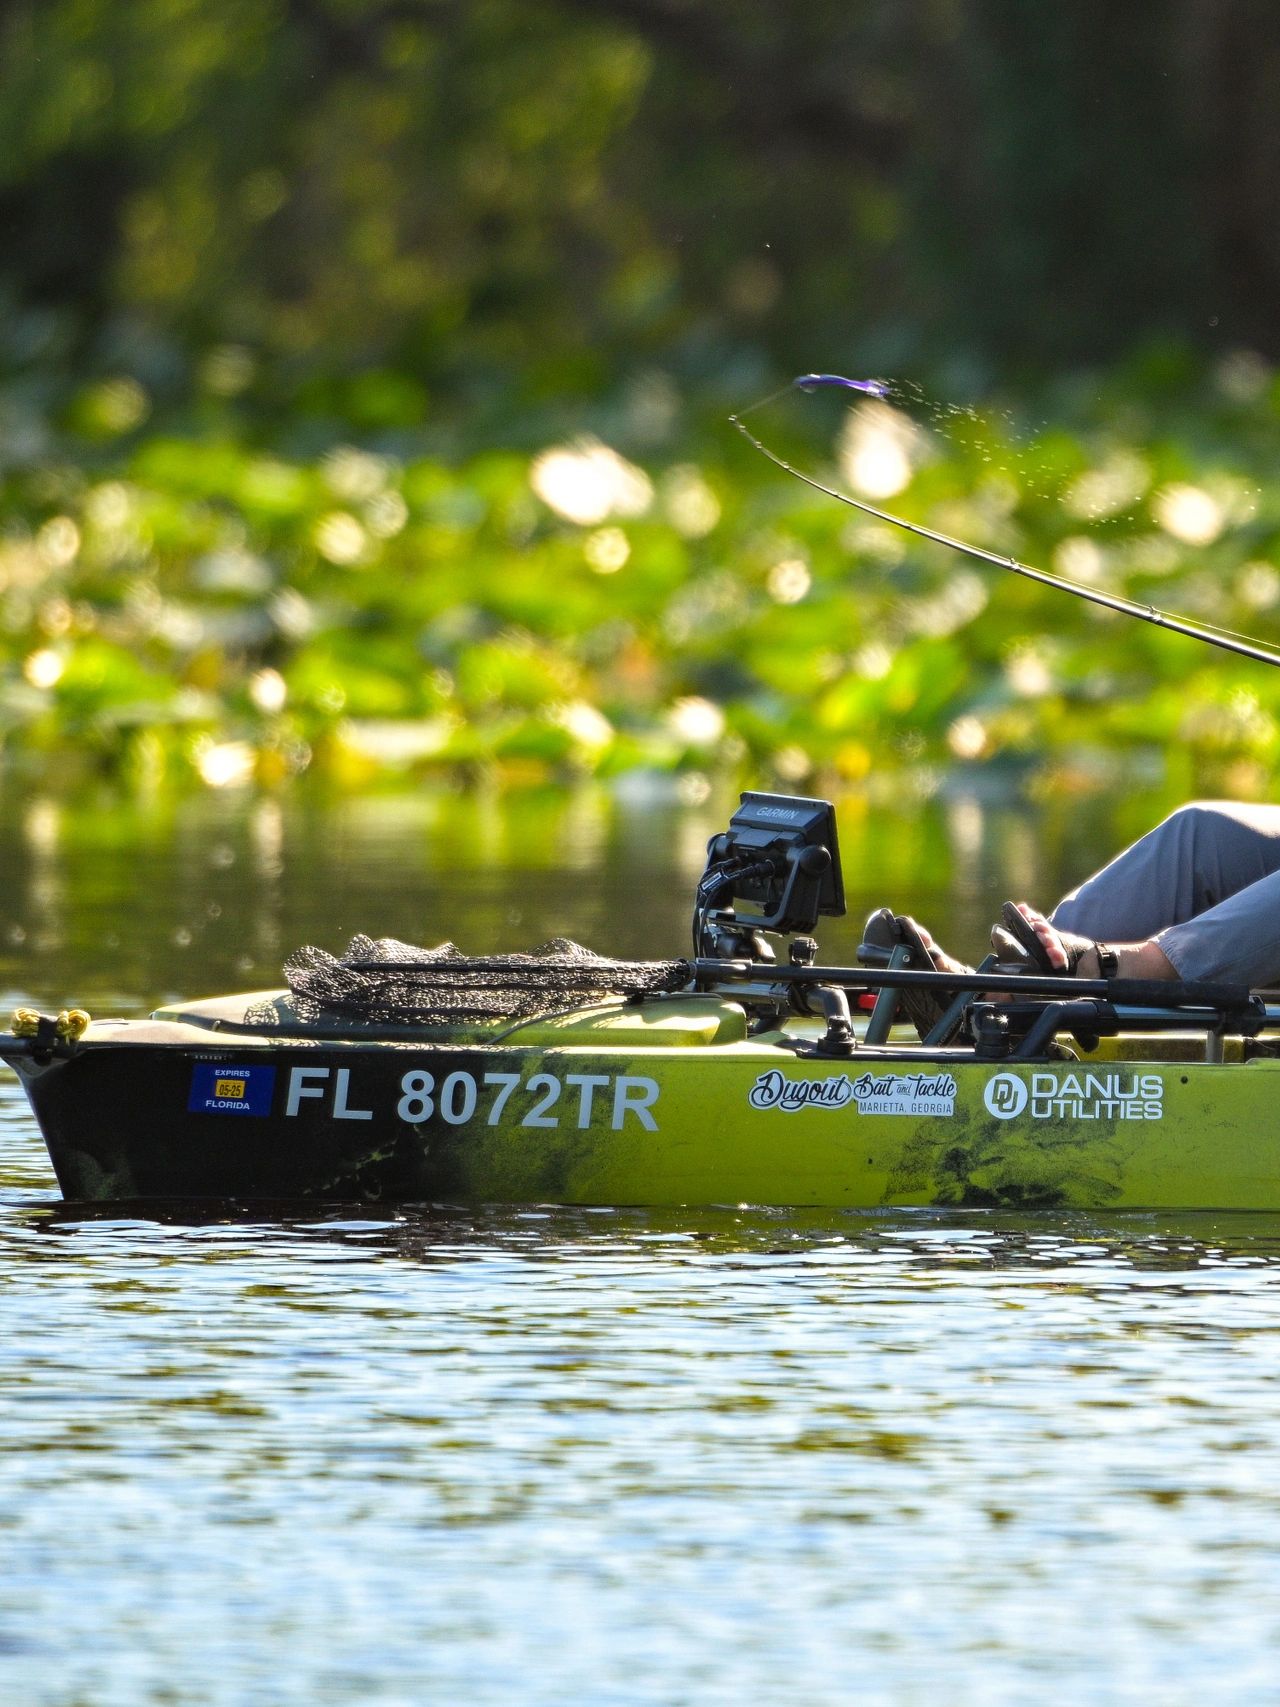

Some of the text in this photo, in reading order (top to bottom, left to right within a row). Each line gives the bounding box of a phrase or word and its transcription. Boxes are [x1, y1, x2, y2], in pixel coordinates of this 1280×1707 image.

[757, 807, 799, 819] GARMIN
[215, 1069, 250, 1077] EXPIRES
[219, 1084, 241, 1096] 05-25
[751, 1071, 850, 1109] Dugout
[854, 1074, 898, 1099] Bait
[908, 1074, 954, 1098] Tackle
[1032, 1074, 1164, 1099] DANUS
[206, 1100, 250, 1110] FLORIDA
[285, 1066, 661, 1132] FL 8072TR
[911, 1102, 952, 1114] GEORGIA
[1032, 1100, 1164, 1120] UTILITIES
